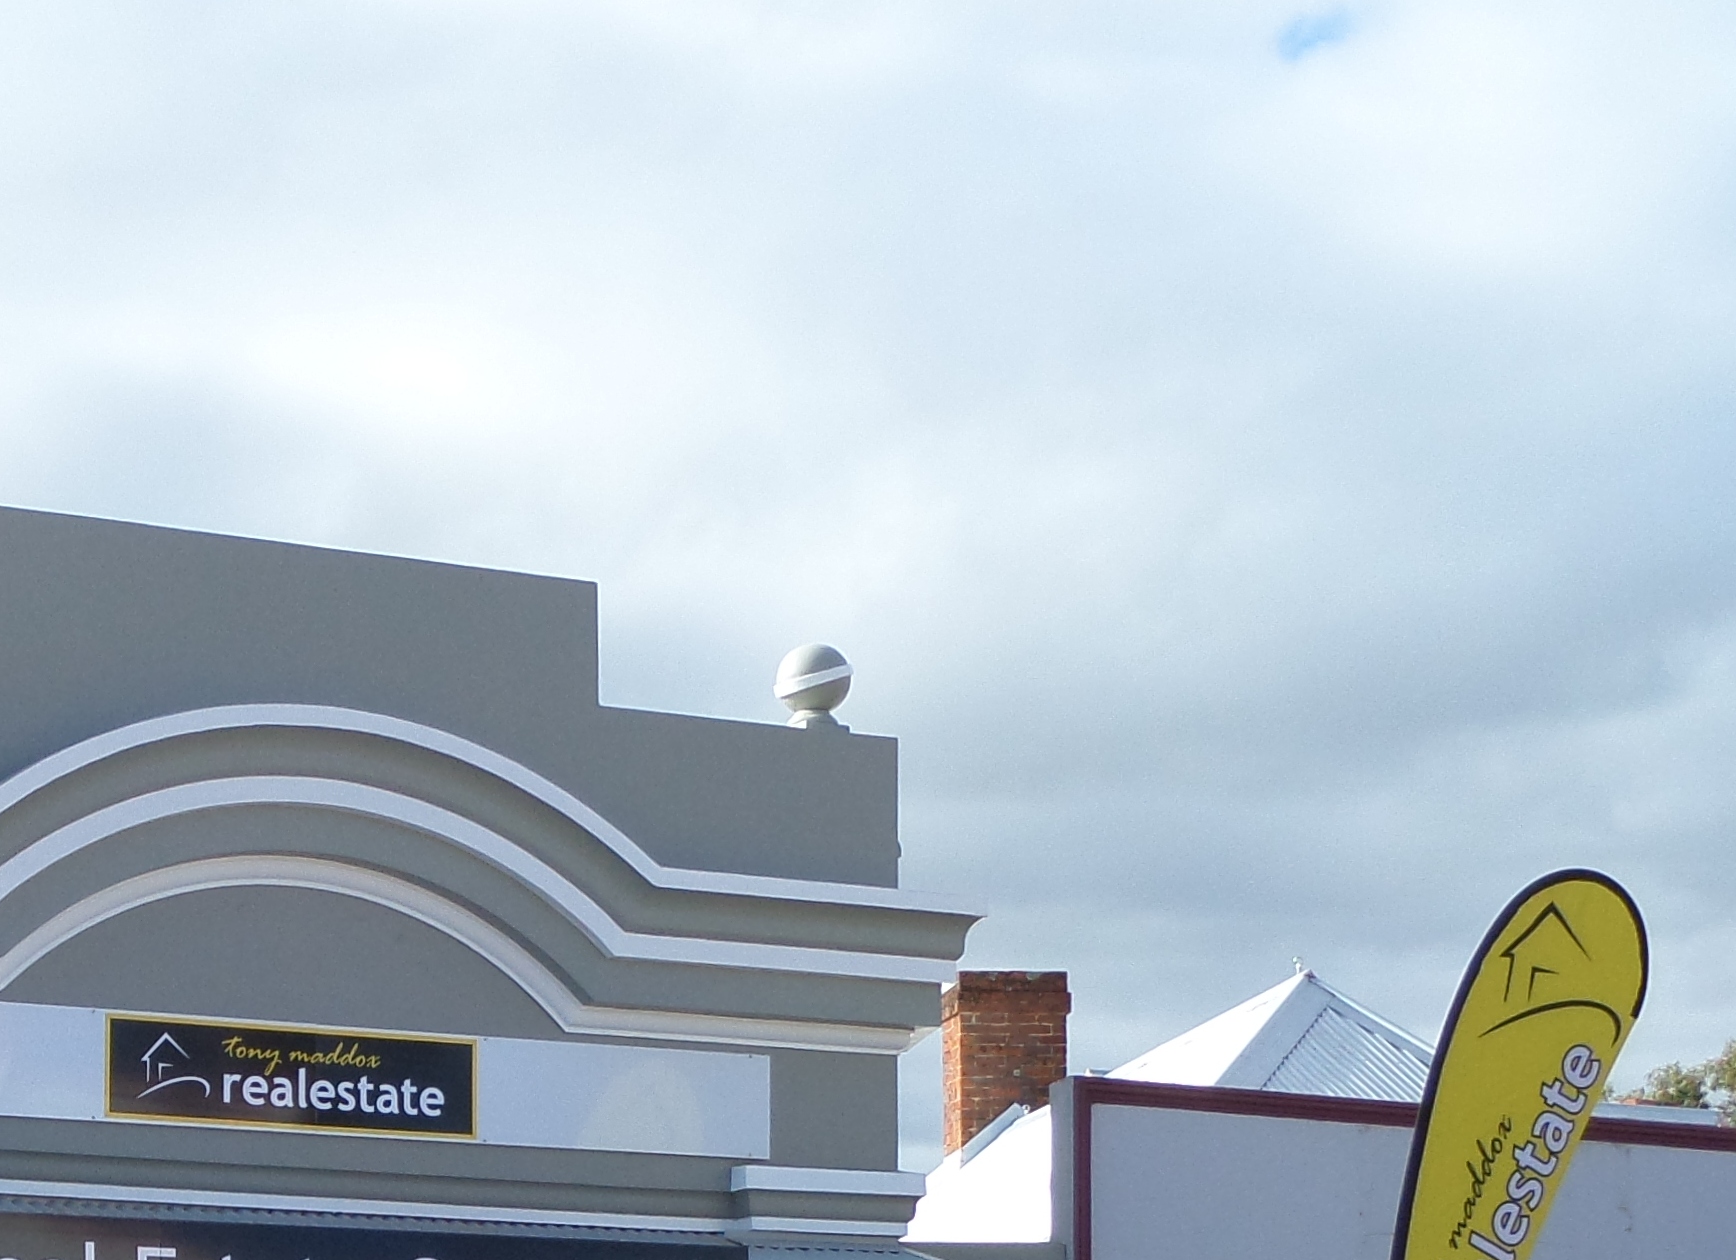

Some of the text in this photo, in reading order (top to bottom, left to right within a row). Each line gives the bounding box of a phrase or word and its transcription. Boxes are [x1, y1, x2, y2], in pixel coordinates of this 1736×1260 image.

[221, 1035, 382, 1075] tony maddox
[222, 1067, 445, 1118] realestate
[1448, 1113, 1513, 1249] maddox
